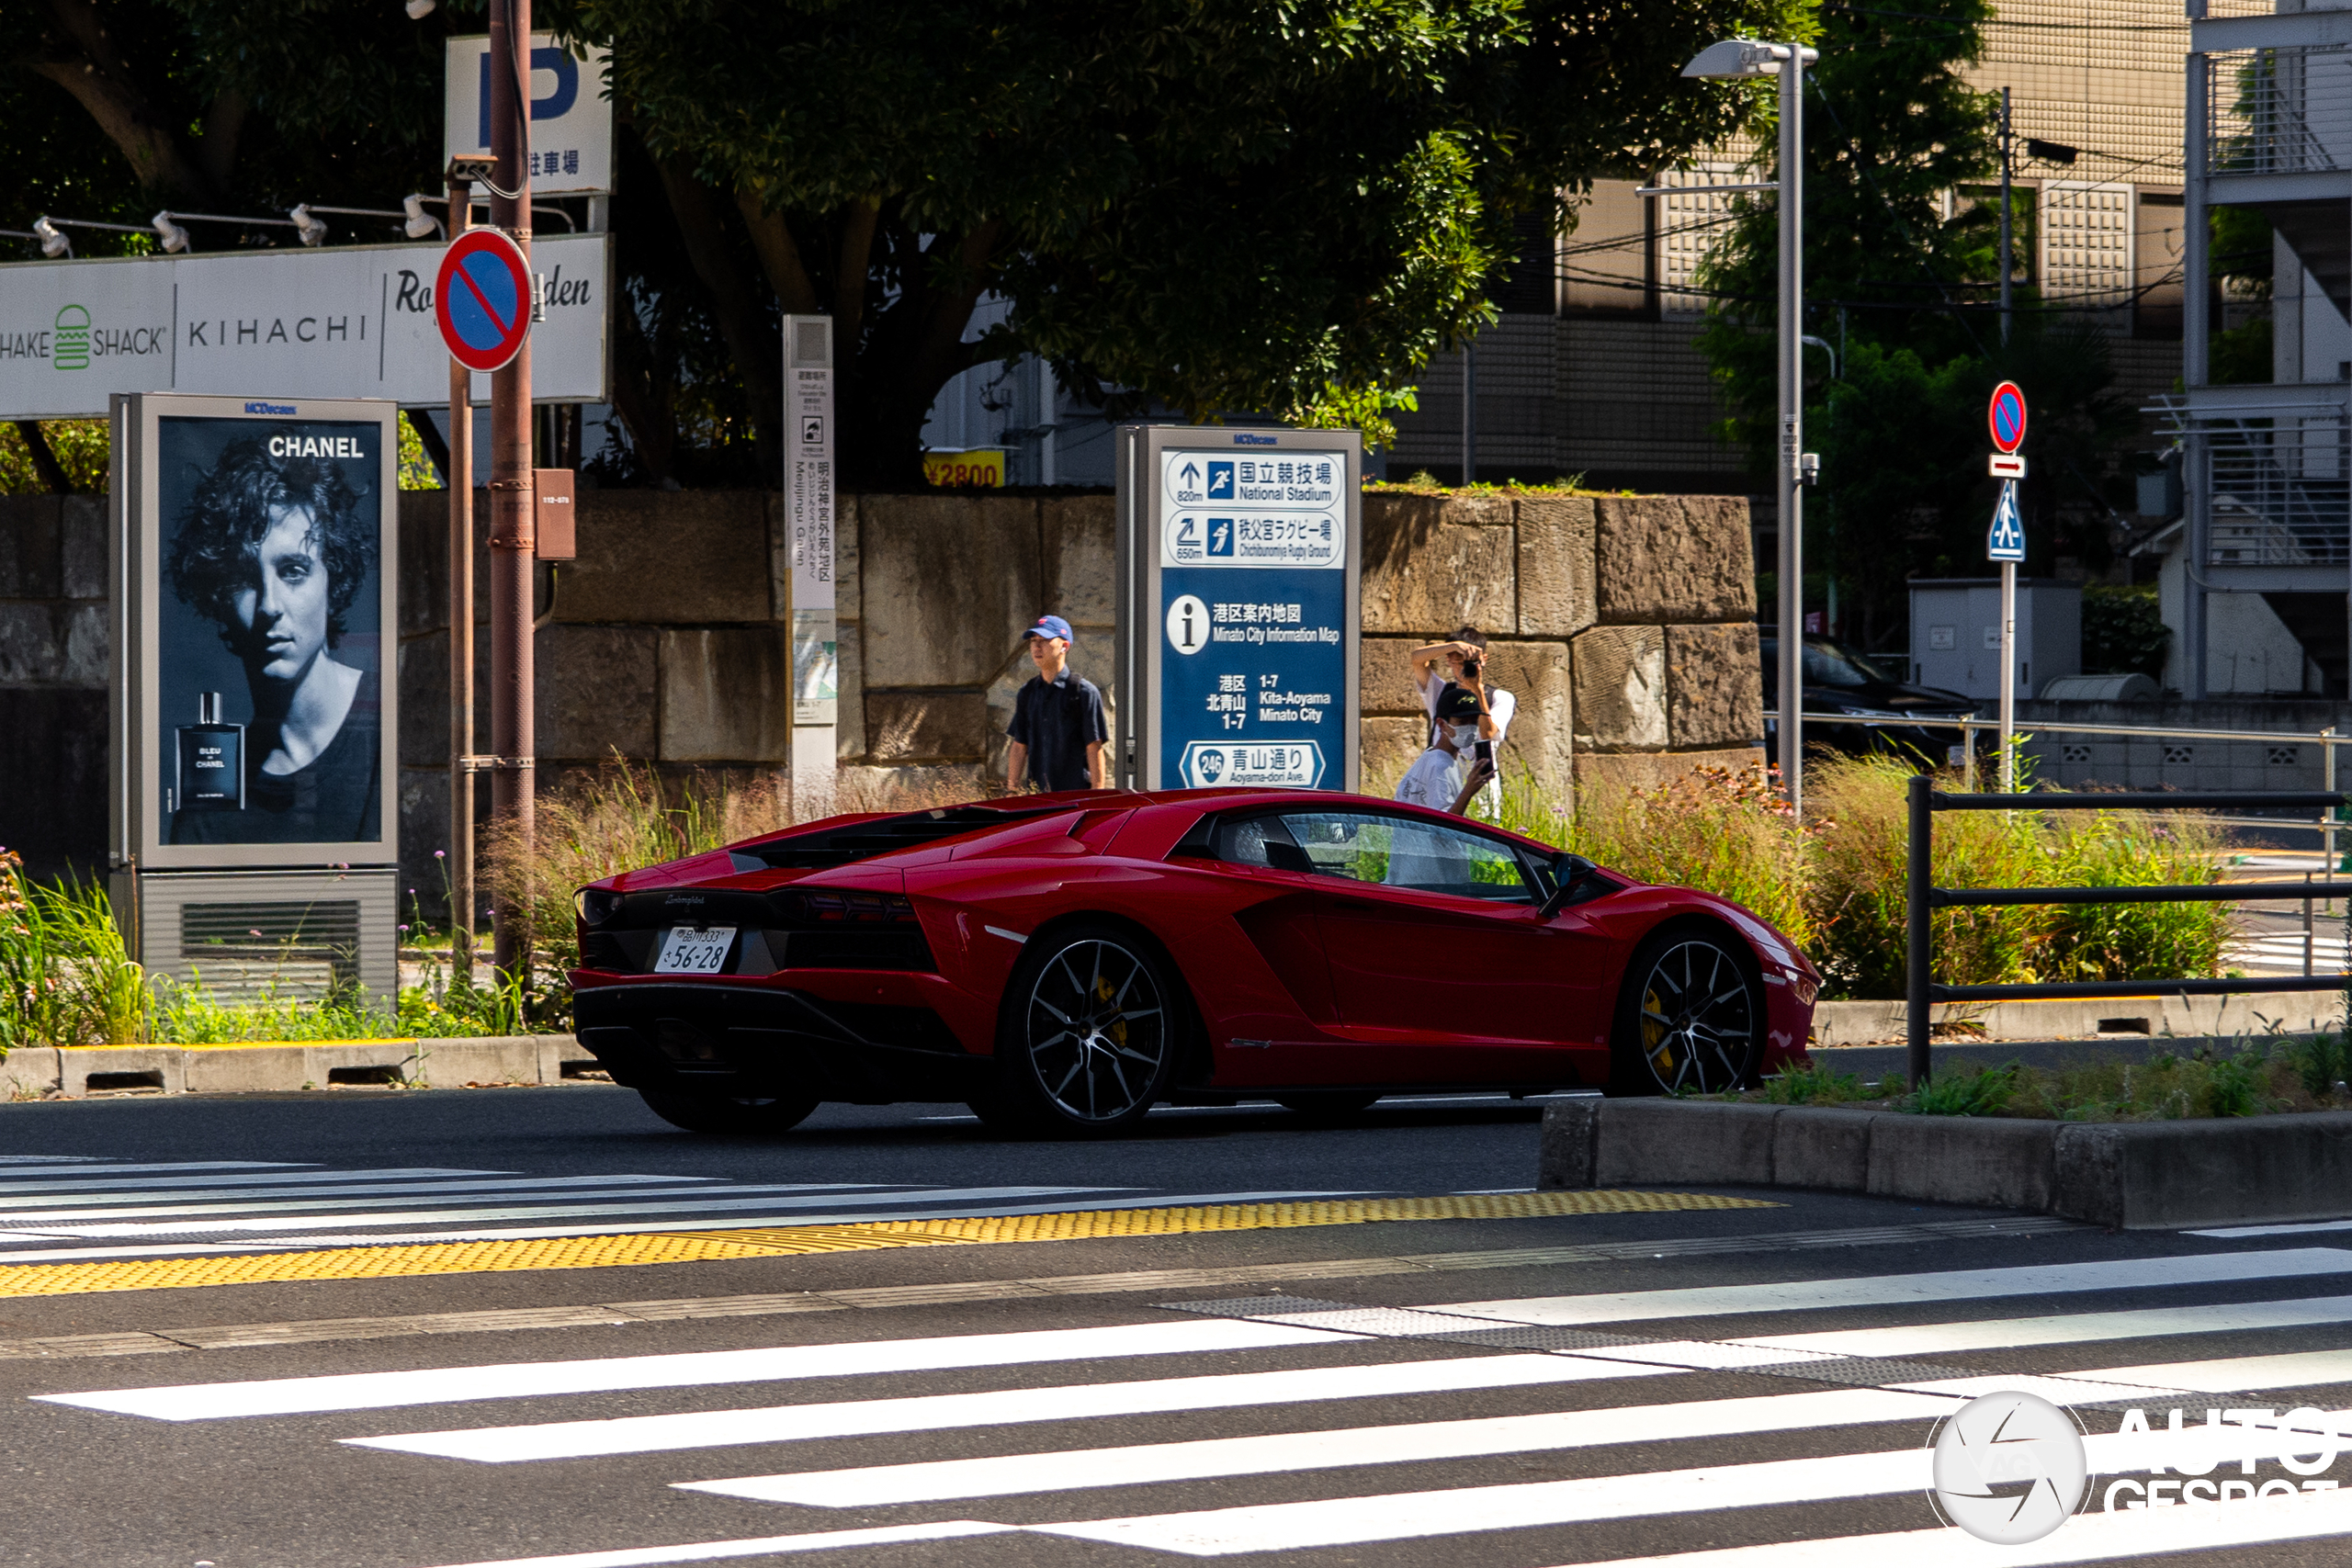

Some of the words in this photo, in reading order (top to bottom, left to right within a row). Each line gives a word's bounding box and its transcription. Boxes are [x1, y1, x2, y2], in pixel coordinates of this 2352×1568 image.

[479, 47, 579, 149] P
[188, 315, 366, 347] KIHACHI
[0, 332, 51, 359] HAKE
[268, 435, 364, 457] CHANEL
[1239, 461, 1331, 485] 国立競技場
[1177, 491, 1204, 502] 820m
[1239, 486, 1284, 501] National
[1287, 487, 1331, 502] Stadium
[1238, 518, 1331, 541] 秩父宮ラグビー場
[1177, 548, 1204, 560] 650m
[1239, 543, 1287, 560] Chichibunomiya
[1288, 544, 1307, 561] Rugby
[1308, 544, 1331, 558] Ground
[1213, 604, 1302, 623] 港区案内地図
[1213, 626, 1245, 642] Minato
[1246, 626, 1265, 645] City
[1266, 626, 1317, 643] Information
[1318, 626, 1340, 646] Map
[1219, 674, 1247, 692] 港区
[1260, 674, 1279, 688] 1-7
[1206, 694, 1247, 712] 北青山
[1260, 691, 1331, 707] Kita-Aoyama
[1222, 713, 1247, 729] 1-7
[1260, 707, 1298, 722] Minato
[1300, 707, 1323, 724] City
[1201, 755, 1223, 774] 246
[1232, 749, 1302, 771] 青山通り
[1229, 772, 1285, 785] Aoyama-dori
[1286, 772, 1306, 783] Ave.
[671, 944, 724, 969] 56-28
